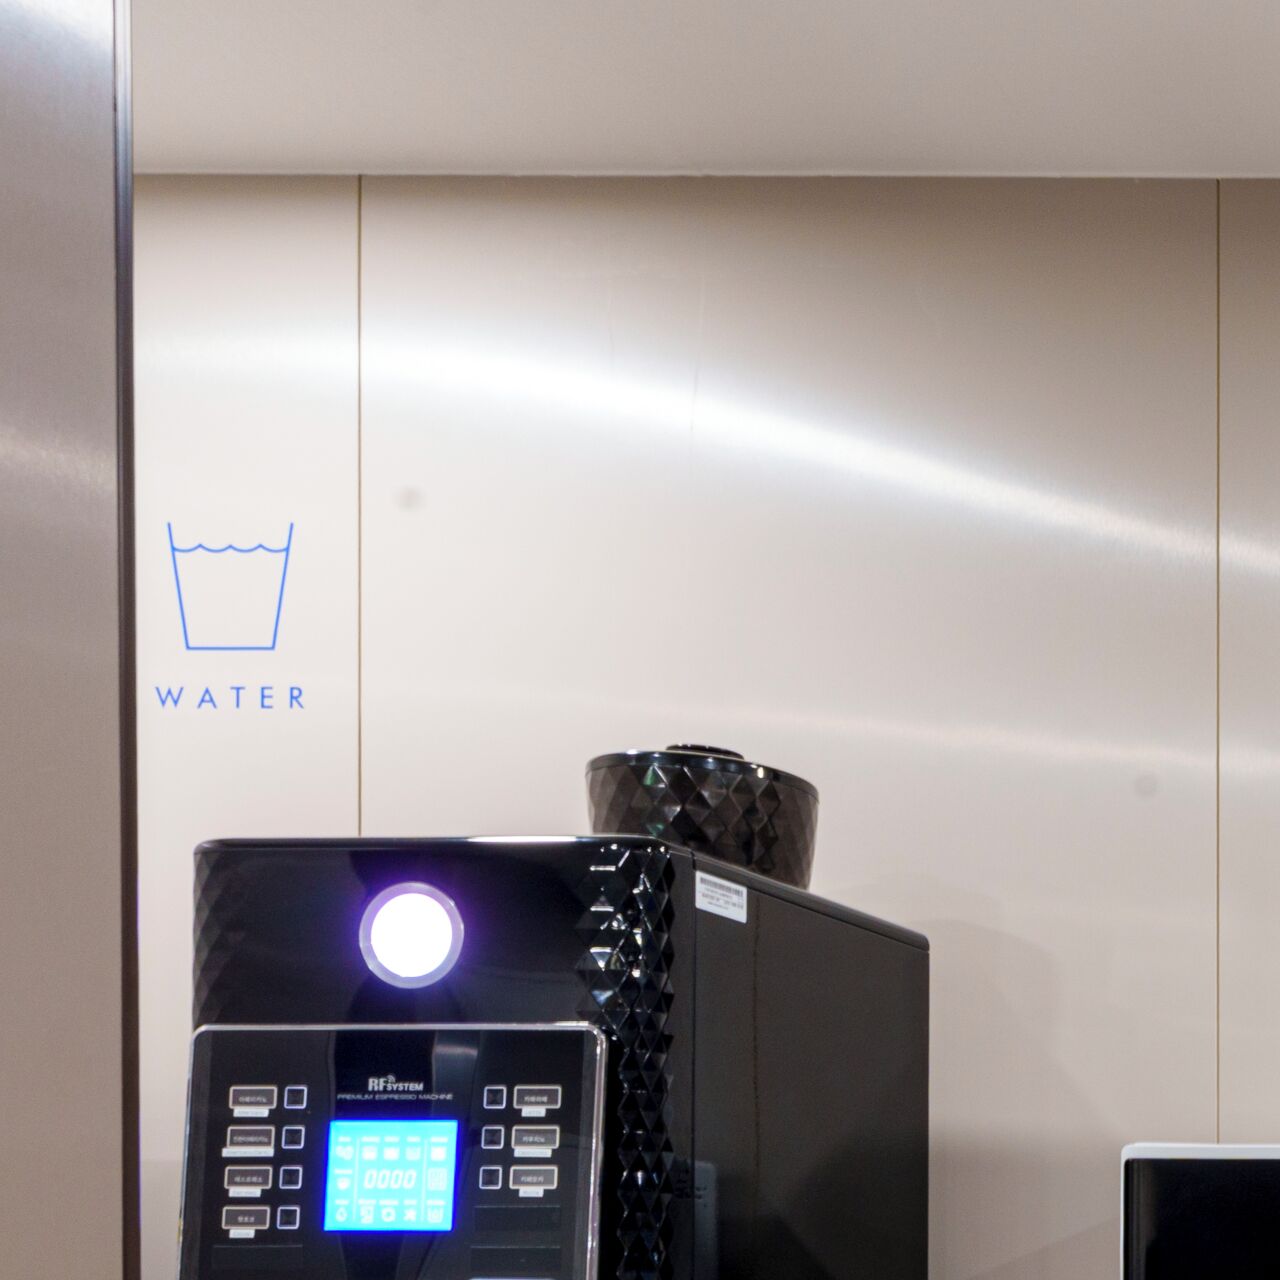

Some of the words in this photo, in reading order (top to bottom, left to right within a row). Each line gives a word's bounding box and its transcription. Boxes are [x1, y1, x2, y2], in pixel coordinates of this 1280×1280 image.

[155, 686, 305, 710] WATER
[337, 1093, 373, 1101] PREMIUM
[418, 1092, 453, 1100] MACHINE
[364, 1168, 417, 1190] 0000
